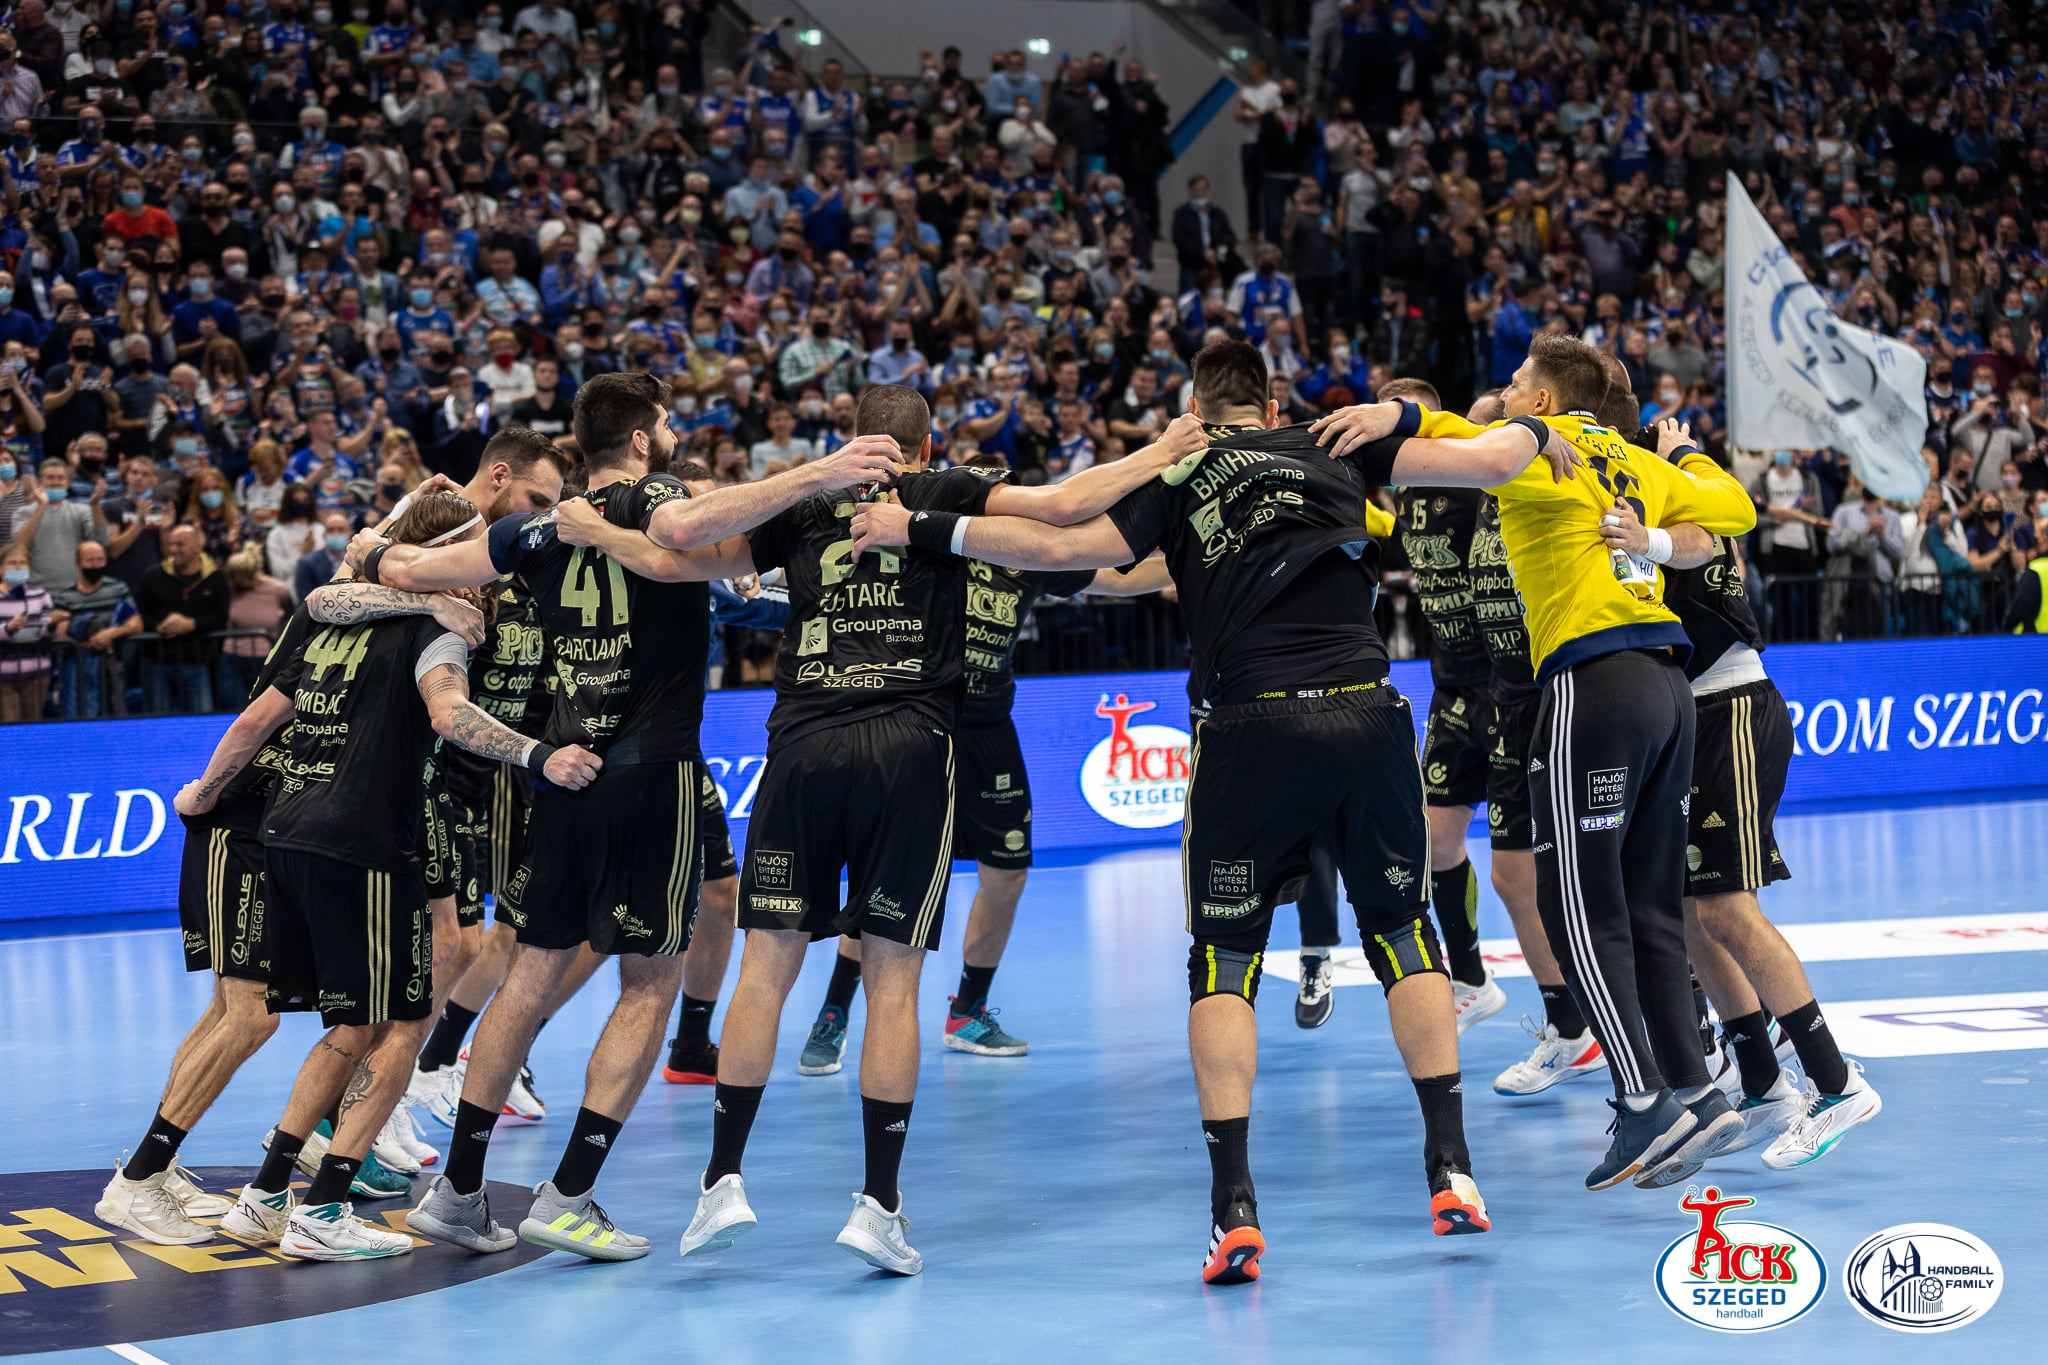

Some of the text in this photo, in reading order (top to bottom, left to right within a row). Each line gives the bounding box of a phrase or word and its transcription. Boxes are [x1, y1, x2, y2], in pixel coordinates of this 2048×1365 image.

[561, 546, 629, 627] 41
[832, 618, 923, 634] Groupama
[304, 623, 374, 682] 44
[828, 659, 923, 678] LEXUS
[822, 676, 885, 688] SZEGED
[1297, 688, 1324, 698] SET
[1341, 681, 1376, 694] PROFCARE
[1907, 688, 2048, 751] SZEG
[1107, 732, 1191, 782] PICK
[1592, 772, 1625, 785] HAJÓS
[981, 789, 1024, 799] Groupama
[1109, 787, 1186, 807] SZEGED
[0, 788, 167, 863] RLD
[1702, 820, 1727, 829] adidas
[757, 855, 788, 867] HAJÓS
[1214, 864, 1248, 875] HAJÓS
[1214, 874, 1248, 885] ÉPÍTÉSZ
[1214, 884, 1248, 893] IRODA
[236, 873, 252, 941] LEXUS
[251, 900, 265, 943] SZEGED
[411, 909, 422, 978] LEXUS
[424, 931, 432, 975] SZEGED
[319, 997, 356, 1008] Alapítvány
[321, 991, 347, 1001] Csányi
